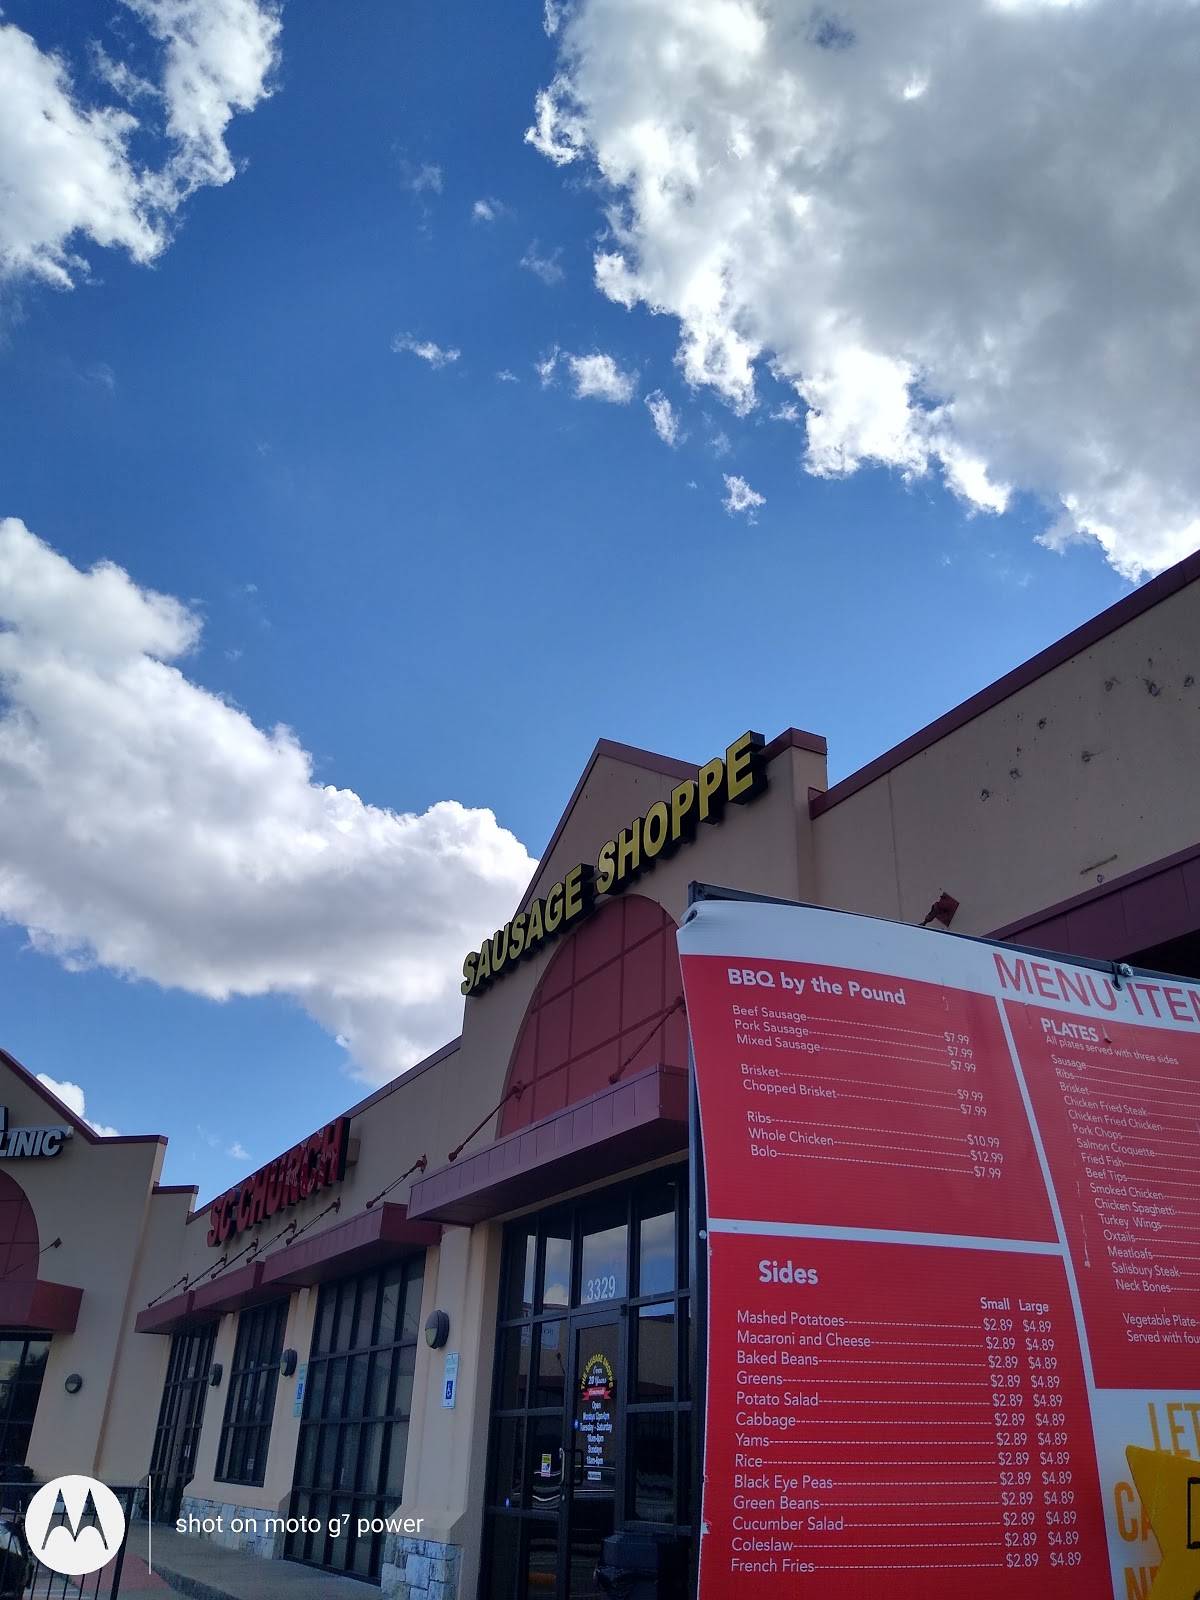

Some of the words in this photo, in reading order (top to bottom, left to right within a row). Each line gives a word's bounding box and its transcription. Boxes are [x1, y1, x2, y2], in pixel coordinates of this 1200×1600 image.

[461, 864, 584, 995] SAUSAGE
[596, 730, 757, 894] SHOPPE
[727, 968, 776, 988] BBQ
[780, 972, 805, 995] by
[811, 976, 843, 995] the
[848, 981, 906, 1005] Pound
[993, 953, 1118, 1011] MENU
[732, 1005, 759, 1016] Beef
[761, 1007, 807, 1022] Sausage
[944, 1032, 969, 1045] $7.99
[1040, 1017, 1099, 1042] PLATES
[734, 1019, 760, 1031] Pork
[764, 1022, 809, 1037] Sausage
[947, 1046, 973, 1058] $7.99
[736, 1034, 772, 1047] Mixed
[775, 1037, 821, 1053] Sausage
[950, 1060, 976, 1072] $7.99
[1046, 1036, 1058, 1046] All
[1059, 1039, 1085, 1050] plates
[1085, 1044, 1113, 1055] served
[1115, 1048, 1133, 1058] with
[1134, 1051, 1156, 1062] three
[1051, 1054, 1087, 1070] Sausage
[741, 1064, 780, 1077] Brisket
[957, 1089, 983, 1102] $9.99
[1055, 1067, 1075, 1079] Ribs
[743, 1079, 796, 1095] Chopped
[799, 1084, 837, 1098] Brisket
[960, 1104, 987, 1117] $7.99
[1060, 1081, 1089, 1095] Brisket
[1064, 1096, 1099, 1109] Chicken
[1100, 1101, 1122, 1113] Fried
[1123, 1105, 1147, 1116] Steak
[747, 1111, 772, 1124] Ribs
[966, 1134, 1000, 1148] $10.99
[1068, 1109, 1103, 1123] Chicken
[1104, 1115, 1127, 1127] Fried
[1128, 1118, 1162, 1131] Chicken
[1072, 1123, 1093, 1135] Pork
[1094, 1127, 1122, 1140] Chops
[748, 1127, 786, 1142] Whole
[789, 1131, 834, 1146] Chicken
[970, 1150, 1004, 1164] $12.99
[1076, 1137, 1110, 1151] Salmon
[1111, 1143, 1156, 1158] Croquette
[751, 1144, 778, 1158] Bolo
[974, 1166, 1001, 1179] $7.99
[1081, 1152, 1105, 1165] Fried
[1107, 1156, 1125, 1168] Fish
[236, 1117, 350, 1233] CHURCH
[1086, 1168, 1107, 1178] Beef
[1109, 1170, 1128, 1183] Tips
[1090, 1183, 1127, 1196] Smoked
[1129, 1187, 1164, 1200] Chicken
[1094, 1198, 1131, 1211] Chicken
[1132, 1202, 1176, 1217] Spaghetti
[1098, 1213, 1129, 1229] Turkey
[1132, 1217, 1162, 1232] Wings
[1103, 1229, 1136, 1242] Oxtails
[1107, 1246, 1153, 1260] Meatloafs
[758, 1259, 819, 1285] Sides
[1111, 1262, 1153, 1278] Salisbury
[1154, 1265, 1181, 1277] Steak
[587, 1275, 616, 1300] 3329
[1115, 1279, 1141, 1292] Neck
[1143, 1279, 1171, 1293] Bones
[980, 1296, 1010, 1311] Small
[1018, 1299, 1049, 1315] Large
[737, 1310, 787, 1325] Mashed
[790, 1312, 845, 1327] Potatoes
[983, 1318, 1012, 1331] $2.89
[1023, 1320, 1051, 1332] $4.89
[1122, 1312, 1171, 1328] Vegetable
[1172, 1314, 1197, 1327] Plate
[737, 1330, 795, 1345] Macaroni
[799, 1333, 822, 1345] and
[825, 1333, 871, 1348] Cheese
[986, 1337, 1015, 1350] $2.89
[1026, 1338, 1054, 1351] $4.89
[1127, 1330, 1160, 1343] Served
[1162, 1332, 1182, 1343] with
[1183, 1331, 1200, 1344] fou
[737, 1350, 777, 1365] Baked
[781, 1352, 819, 1365] Beans
[988, 1355, 1018, 1368] $2.89
[1028, 1357, 1057, 1369] $4.89
[736, 1371, 783, 1385] Greens
[991, 1374, 1020, 1387] $2.89
[1031, 1375, 1060, 1388] $4.89
[736, 1391, 780, 1405] Potato
[784, 1392, 819, 1406] Salad
[993, 1393, 1022, 1407] $2.89
[1033, 1394, 1062, 1407] $4.89
[735, 1412, 796, 1430] Cabbage
[995, 1413, 1025, 1426] $2.89
[1036, 1413, 1064, 1426] $4.89
[735, 1433, 770, 1447] Yams
[996, 1433, 1027, 1446] $2.89
[1038, 1433, 1067, 1446] $4.89
[735, 1453, 763, 1467] Rice
[998, 1452, 1029, 1465] $2.89
[1040, 1452, 1070, 1465] $4.89
[734, 1474, 770, 1489] Black
[774, 1475, 798, 1492] Eye
[802, 1475, 833, 1489] Peas
[1000, 1472, 1031, 1485] $2.89
[1042, 1471, 1072, 1485] $4.89
[733, 1495, 775, 1509] Green
[780, 1495, 820, 1510] Beans
[1002, 1492, 1032, 1505] $2.89
[1044, 1491, 1074, 1504] $4.89
[732, 1516, 803, 1531] Cucumber
[807, 1516, 844, 1531] Salad
[1003, 1512, 1034, 1526] $2.89
[1046, 1511, 1076, 1525] $4.89
[731, 1537, 794, 1551] Coleslaw
[1005, 1533, 1036, 1547] $2.89
[1048, 1531, 1079, 1545] $4.89
[731, 1558, 777, 1572] French
[782, 1558, 815, 1572] Fries
[1006, 1553, 1038, 1568] $2.89
[1050, 1552, 1081, 1566] $4.89
